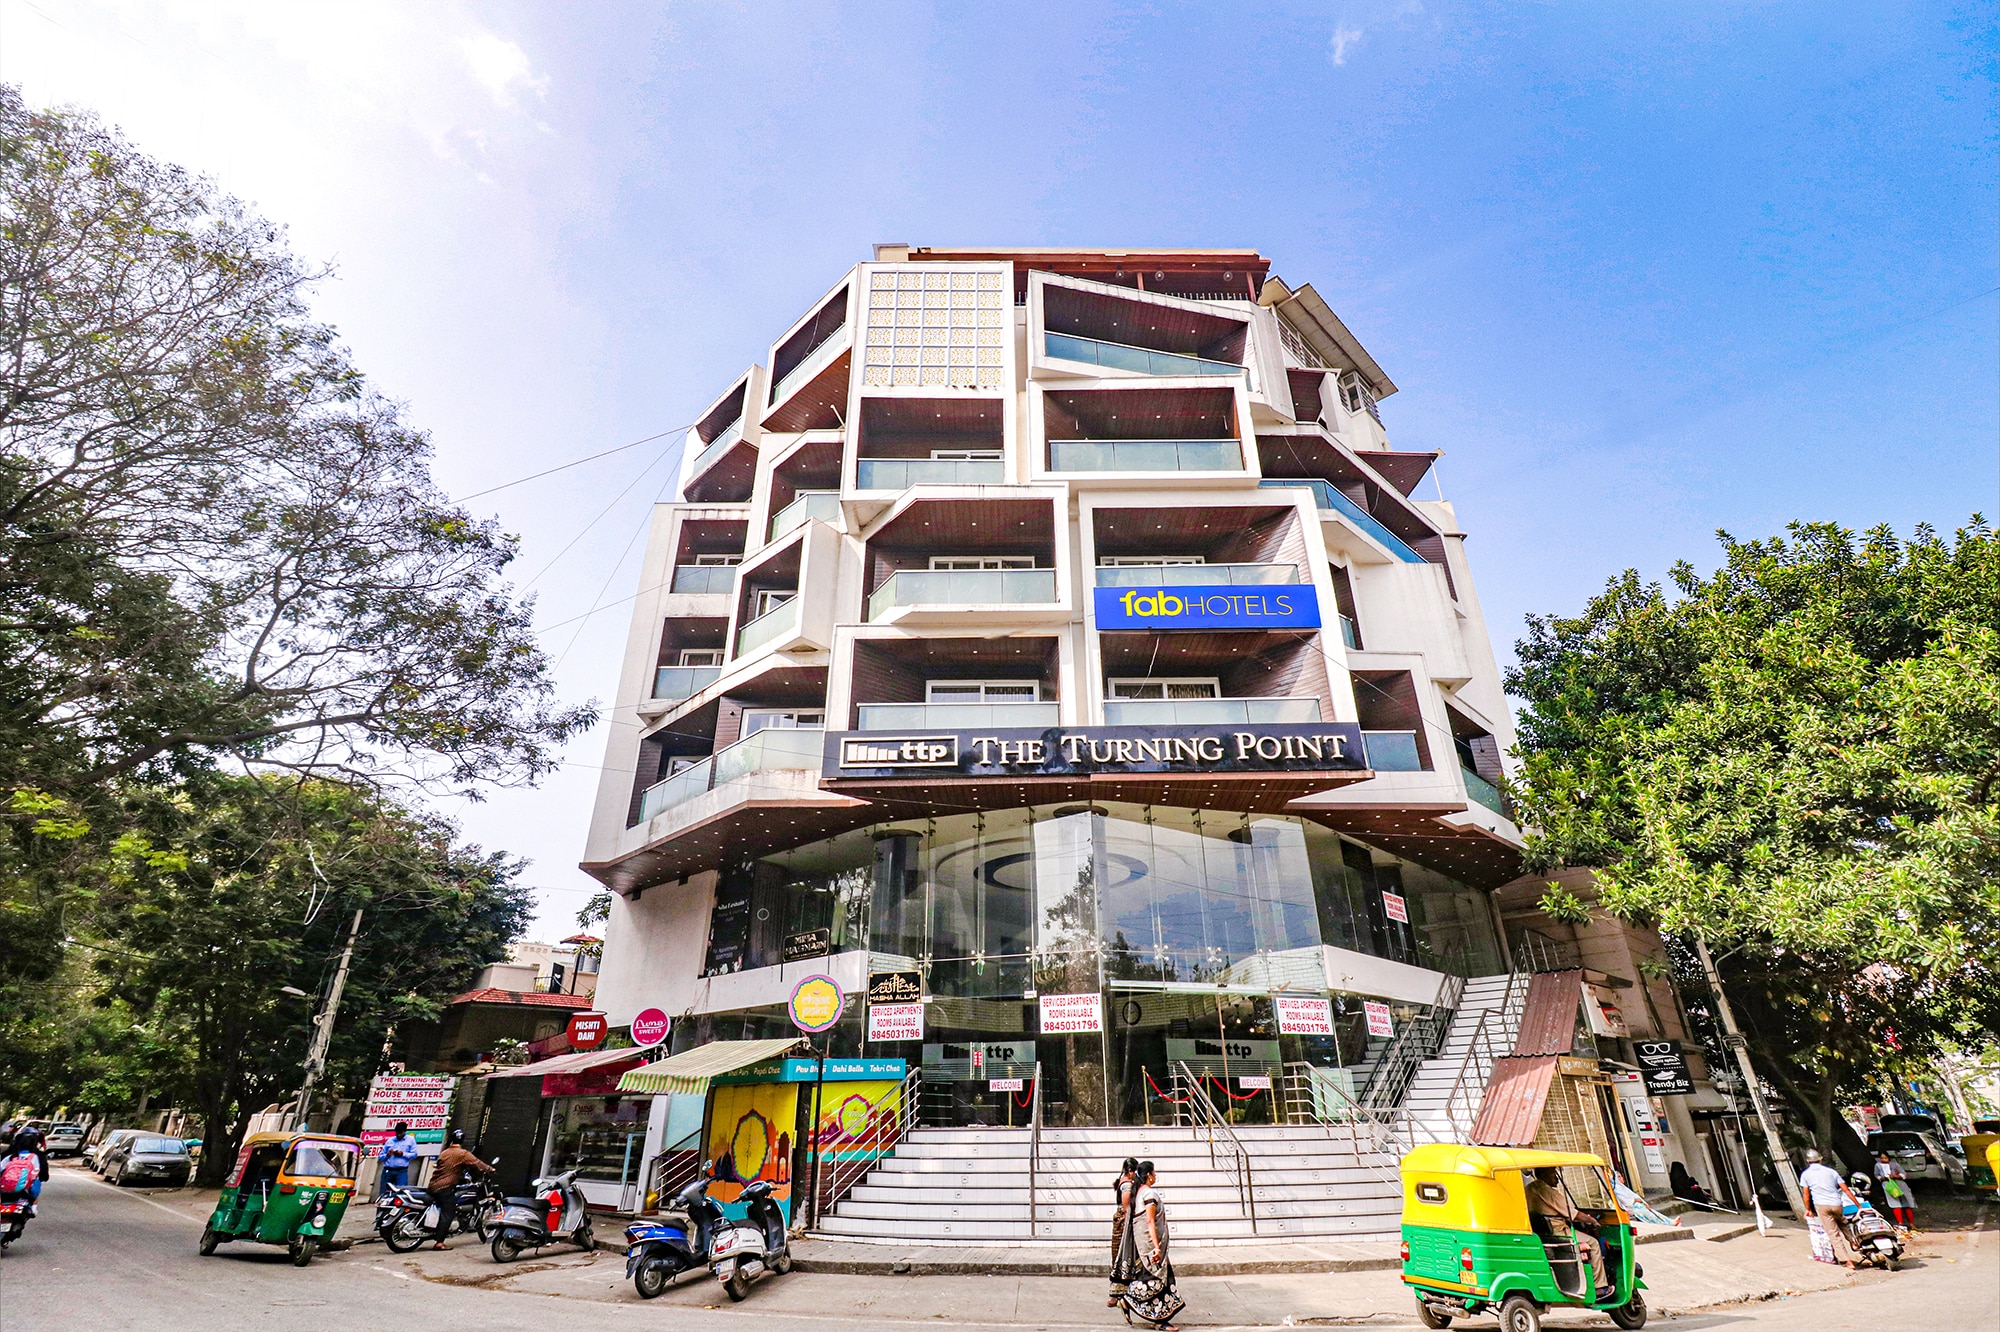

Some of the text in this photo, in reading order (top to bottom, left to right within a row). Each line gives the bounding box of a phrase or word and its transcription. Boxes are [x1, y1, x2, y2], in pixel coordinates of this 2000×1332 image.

[1119, 590, 1293, 617] fabHOTELS
[899, 741, 947, 761] ttp
[972, 732, 1347, 765] THE TURNING POINT
[1043, 995, 1099, 1007] SERVICED APARTMENTS
[1279, 1000, 1328, 1010] SERVICED APARTMENTS
[872, 1006, 922, 1017] SERVICED APARTMENTS
[1049, 1008, 1093, 1018] ROOMS AVAILABLE
[1286, 1011, 1325, 1021] ROOMS AVAILABLE
[575, 1020, 600, 1030] MISHTI
[877, 1017, 916, 1027] ROOMS AVAILABLE
[1044, 1020, 1099, 1031] 9845031796
[1282, 1023, 1330, 1033] 9845031796
[577, 1031, 595, 1041] DAHI
[871, 1028, 920, 1039] 9845031796
[986, 1045, 1015, 1061] ttp
[1225, 1043, 1252, 1059] ttp
[809, 1064, 827, 1075] Bhji
[991, 1081, 1021, 1090] WELCOME
[1241, 1079, 1270, 1087] WELCOME
[1647, 1079, 1690, 1089] Trendy Biz
[373, 1090, 402, 1098] HOUSE
[369, 1104, 446, 1114] NAYAAB'S CONSTRUCTIONS
[415, 1118, 444, 1128] DESIGNER
